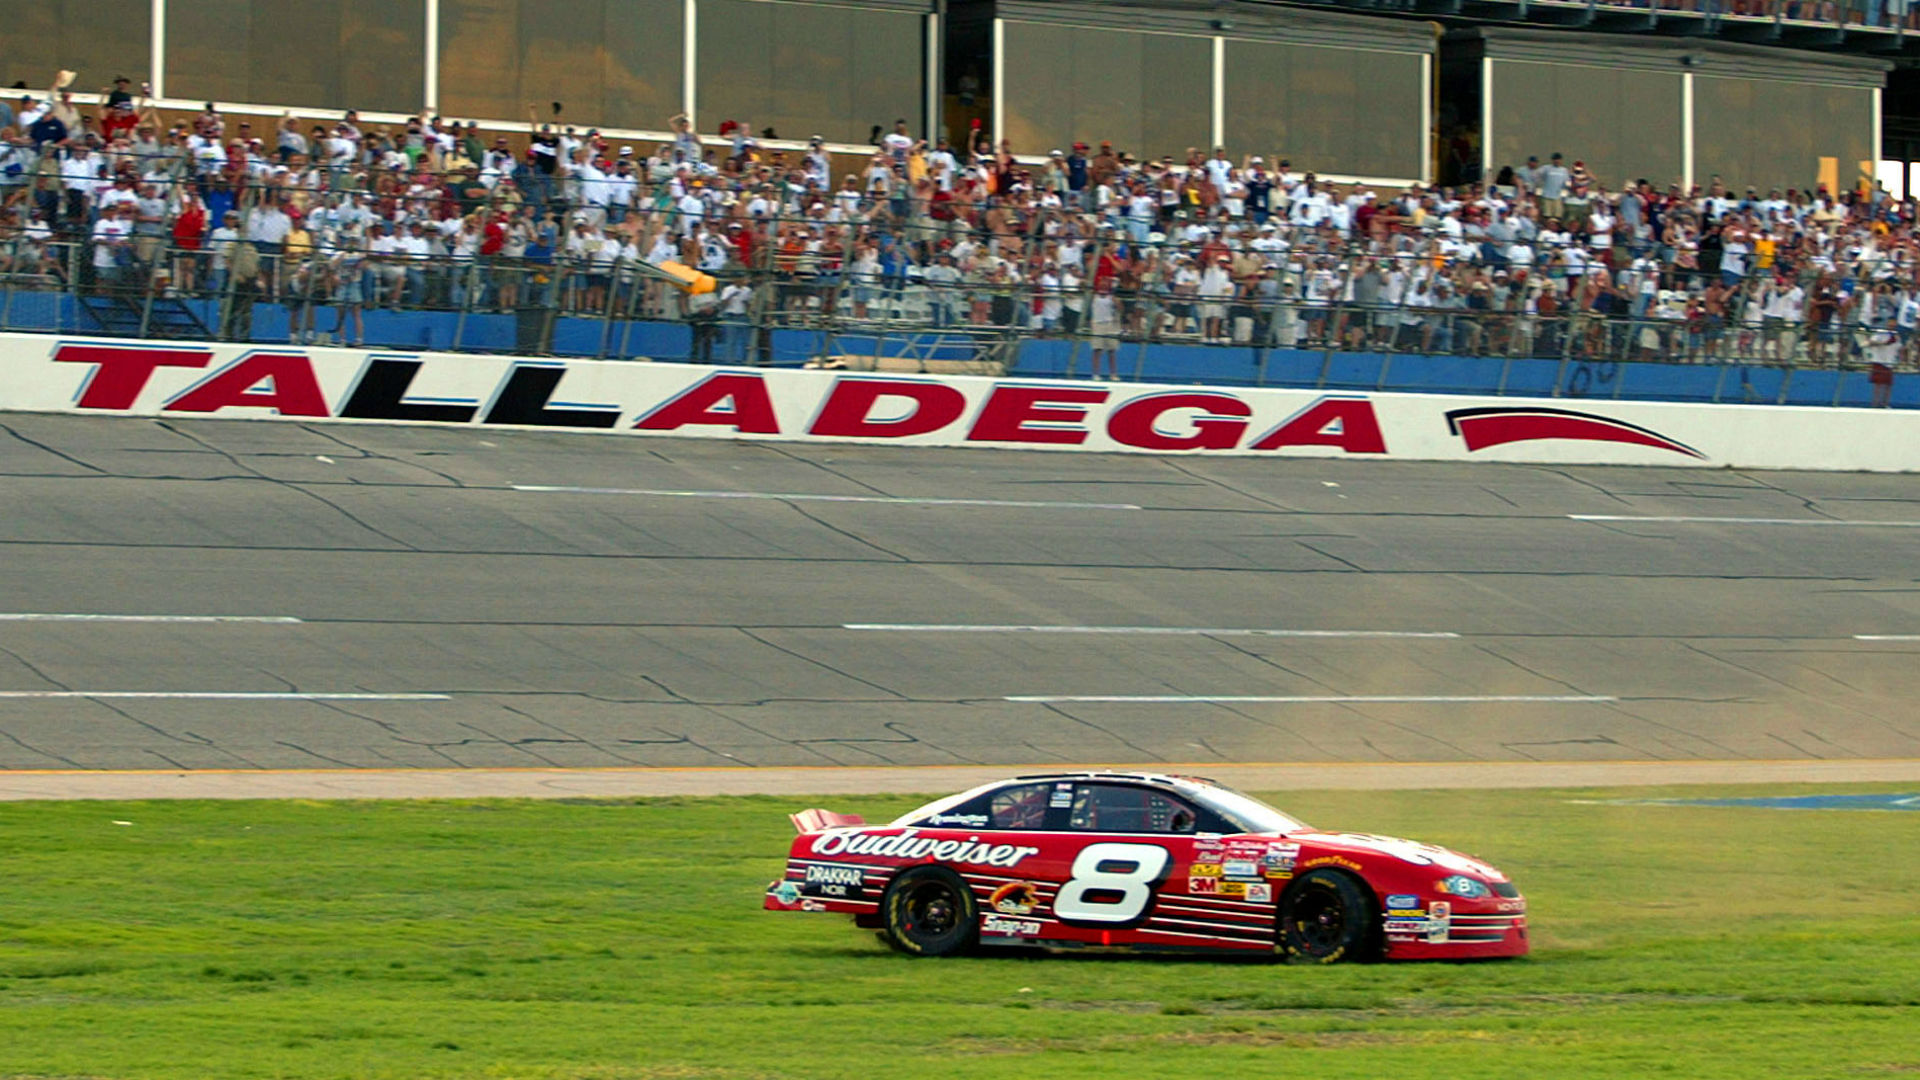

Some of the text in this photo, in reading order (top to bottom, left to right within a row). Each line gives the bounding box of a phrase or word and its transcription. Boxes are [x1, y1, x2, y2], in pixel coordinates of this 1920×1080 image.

[51, 341, 1388, 455] TALLADEGA
[811, 829, 1040, 867] Budweiser
[806, 865, 862, 886] DRAKKAR
[1053, 842, 1170, 922] 8
[1190, 878, 1217, 894] 3M
[821, 884, 847, 896] NOIR
[981, 914, 1041, 937] Snap-on
